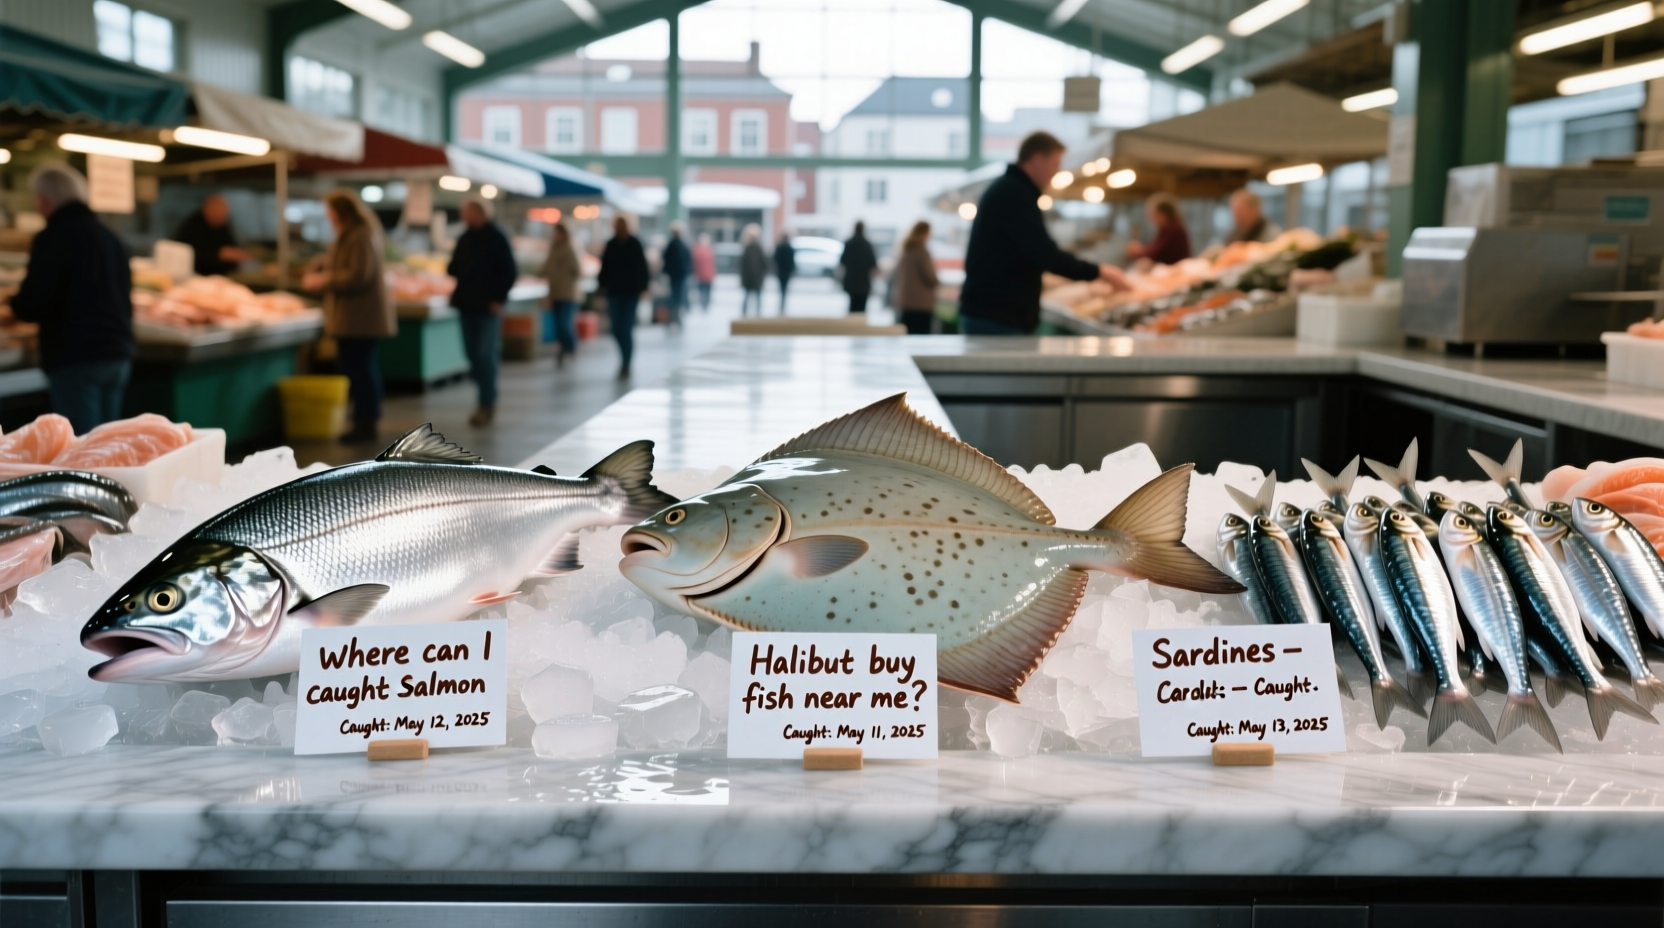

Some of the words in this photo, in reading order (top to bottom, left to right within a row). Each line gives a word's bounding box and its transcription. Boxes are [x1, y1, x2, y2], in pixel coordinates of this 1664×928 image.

[320, 636, 410, 670] Where
[422, 643, 469, 663] can
[750, 643, 855, 676] Halibut
[869, 643, 916, 684] buy
[1152, 636, 1276, 669] Sardines
[306, 674, 390, 709] caught
[396, 670, 486, 698] Salmon
[741, 681, 794, 715] fish
[804, 690, 863, 710] near
[870, 679, 928, 712] me?
[339, 717, 391, 739] Caught:
[393, 715, 425, 736] May
[430, 714, 449, 731] 12,
[454, 711, 491, 727] 2025
[782, 723, 832, 745] Caught:
[836, 724, 865, 745] May
[871, 725, 886, 741] 11,
[890, 723, 927, 739] 2025
[1187, 719, 1234, 743] Caught:
[1238, 719, 1266, 741] May
[1272, 718, 1290, 735] 13,
[1293, 716, 1329, 732] 2025
